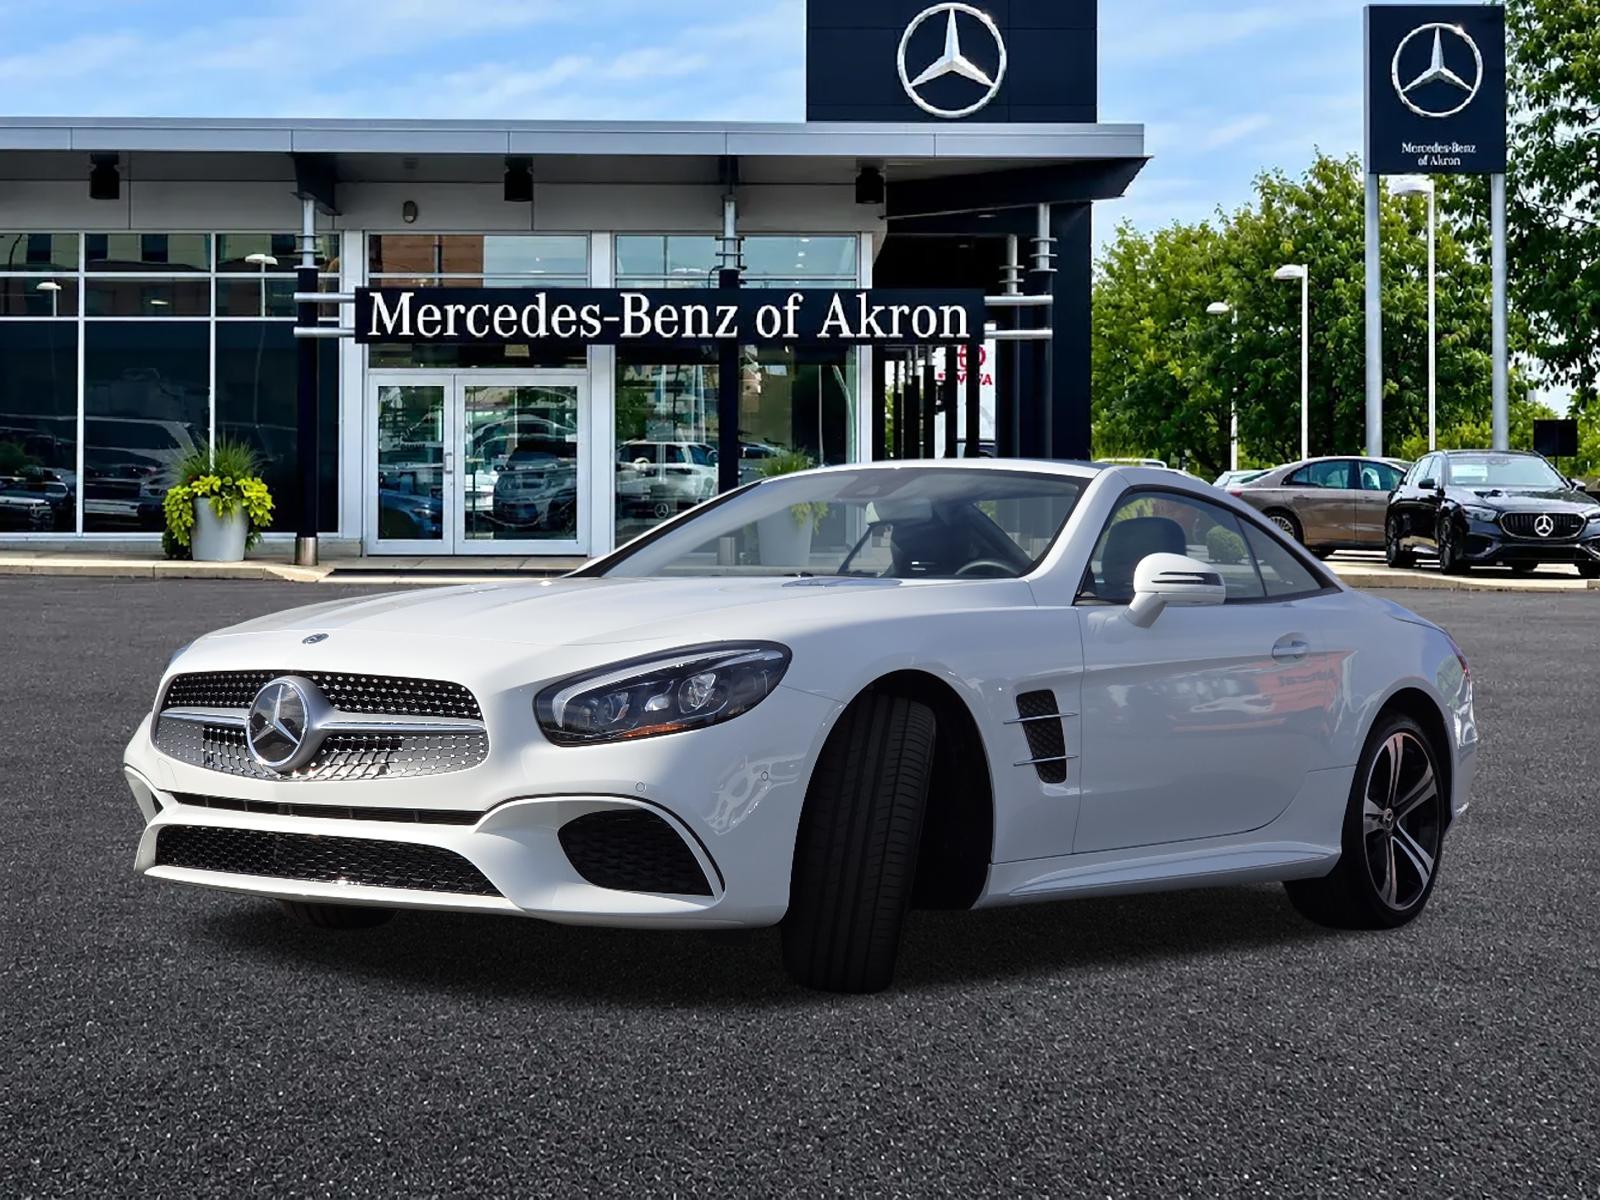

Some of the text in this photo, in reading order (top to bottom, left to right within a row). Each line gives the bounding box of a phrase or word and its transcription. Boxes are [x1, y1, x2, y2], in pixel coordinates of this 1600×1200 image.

[1401, 141, 1477, 154] Mercedes-Benz
[1417, 154, 1461, 166] of Akron
[367, 291, 971, 340] Mercedes-Benz of Akron
